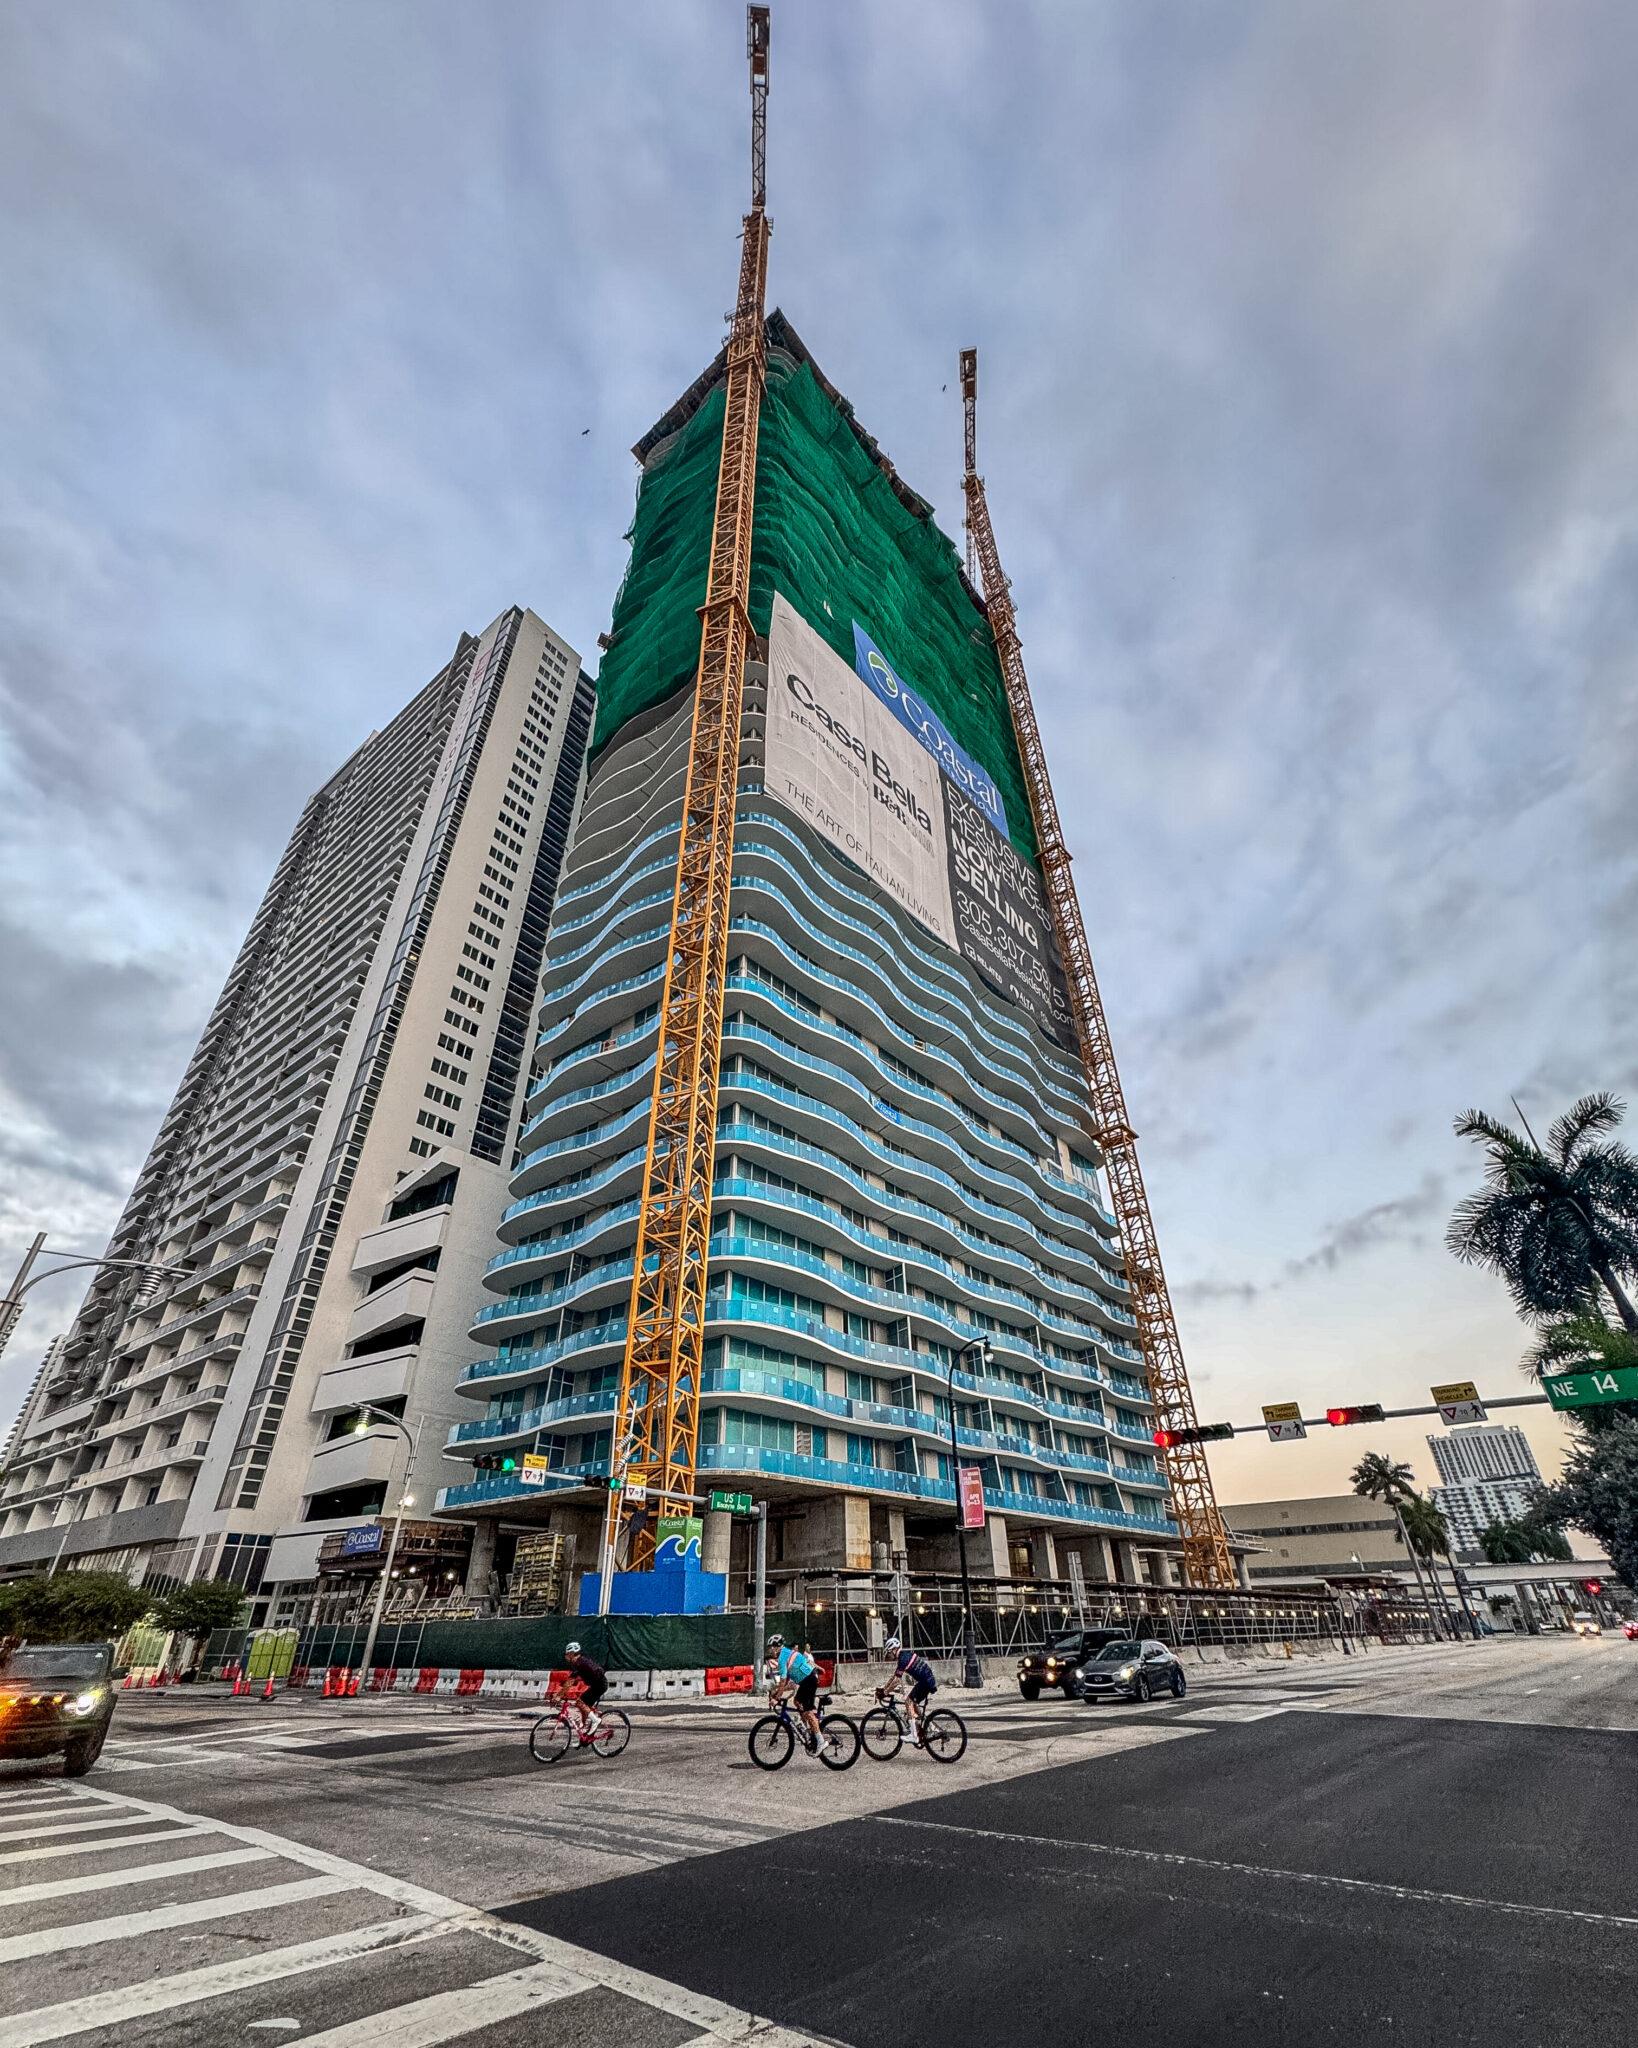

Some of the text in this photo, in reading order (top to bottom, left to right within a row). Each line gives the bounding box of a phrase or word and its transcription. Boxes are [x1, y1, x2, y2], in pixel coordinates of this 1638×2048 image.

[787, 674, 932, 836] Casa Bella
[790, 710, 860, 777] RESIDENCES
[902, 692, 999, 816] Coastal
[785, 779, 941, 932] THE ART OF ITALIAN LIVING
[946, 782, 1038, 894] EXCLUSIVE
[950, 803, 1052, 932] RESIDENCES
[952, 828, 1001, 891] NOW
[955, 854, 1039, 950] SELLING
[1551, 1374, 1619, 1397] NE 14
[354, 1529, 380, 1545] Coastal
[724, 1493, 734, 1503] US
